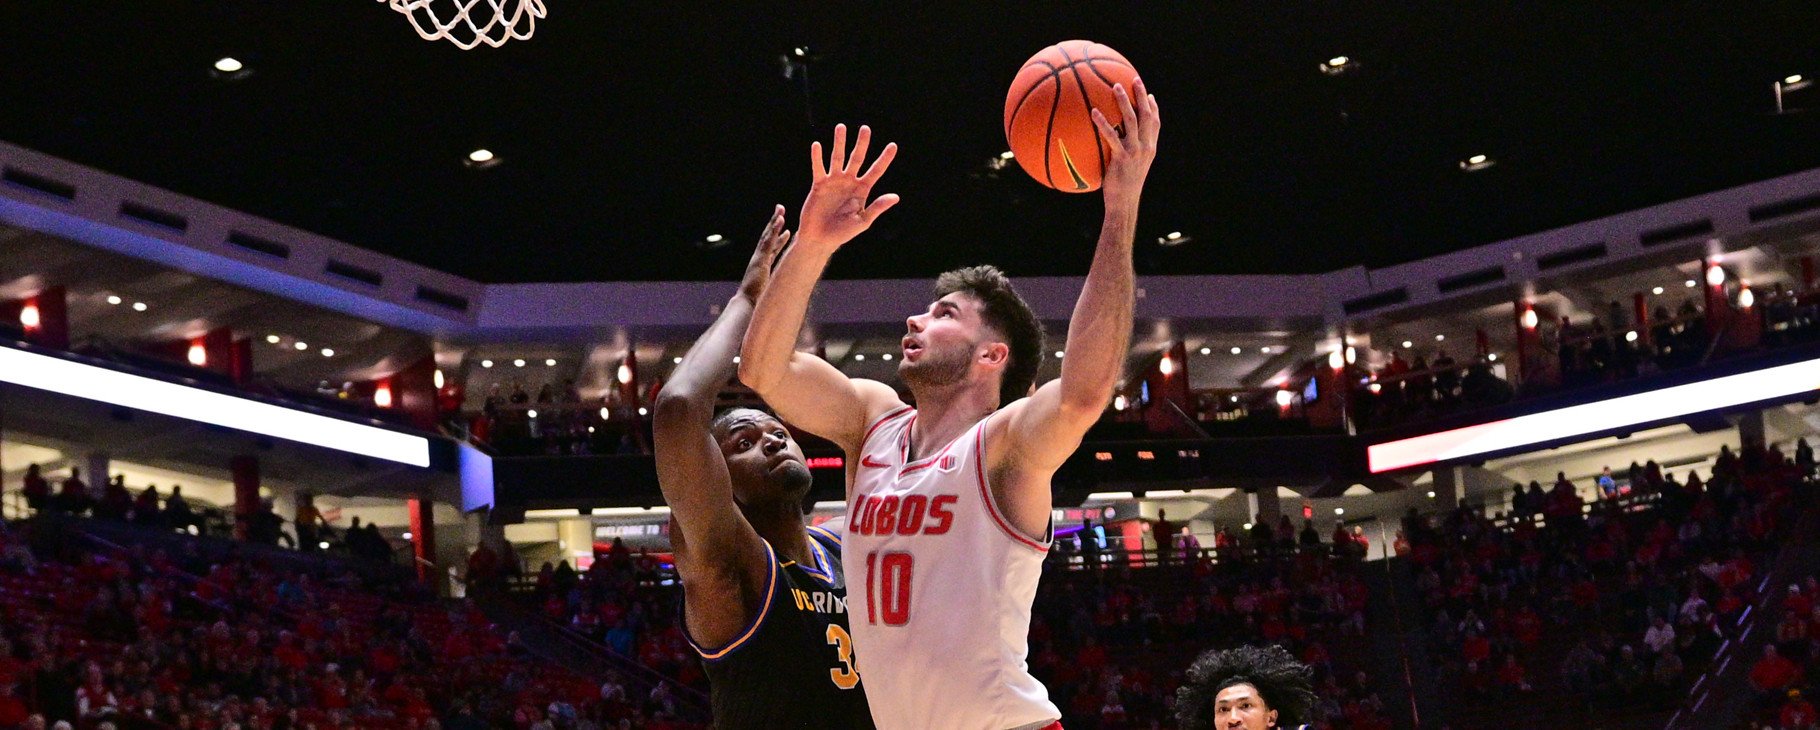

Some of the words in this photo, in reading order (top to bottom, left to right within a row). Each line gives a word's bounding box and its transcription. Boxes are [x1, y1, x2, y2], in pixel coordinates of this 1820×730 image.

[595, 525, 645, 538] WELCOME
[647, 524, 660, 535] TO
[849, 494, 959, 536] LOBOS
[866, 550, 915, 627] 10
[826, 623, 860, 690] 3
